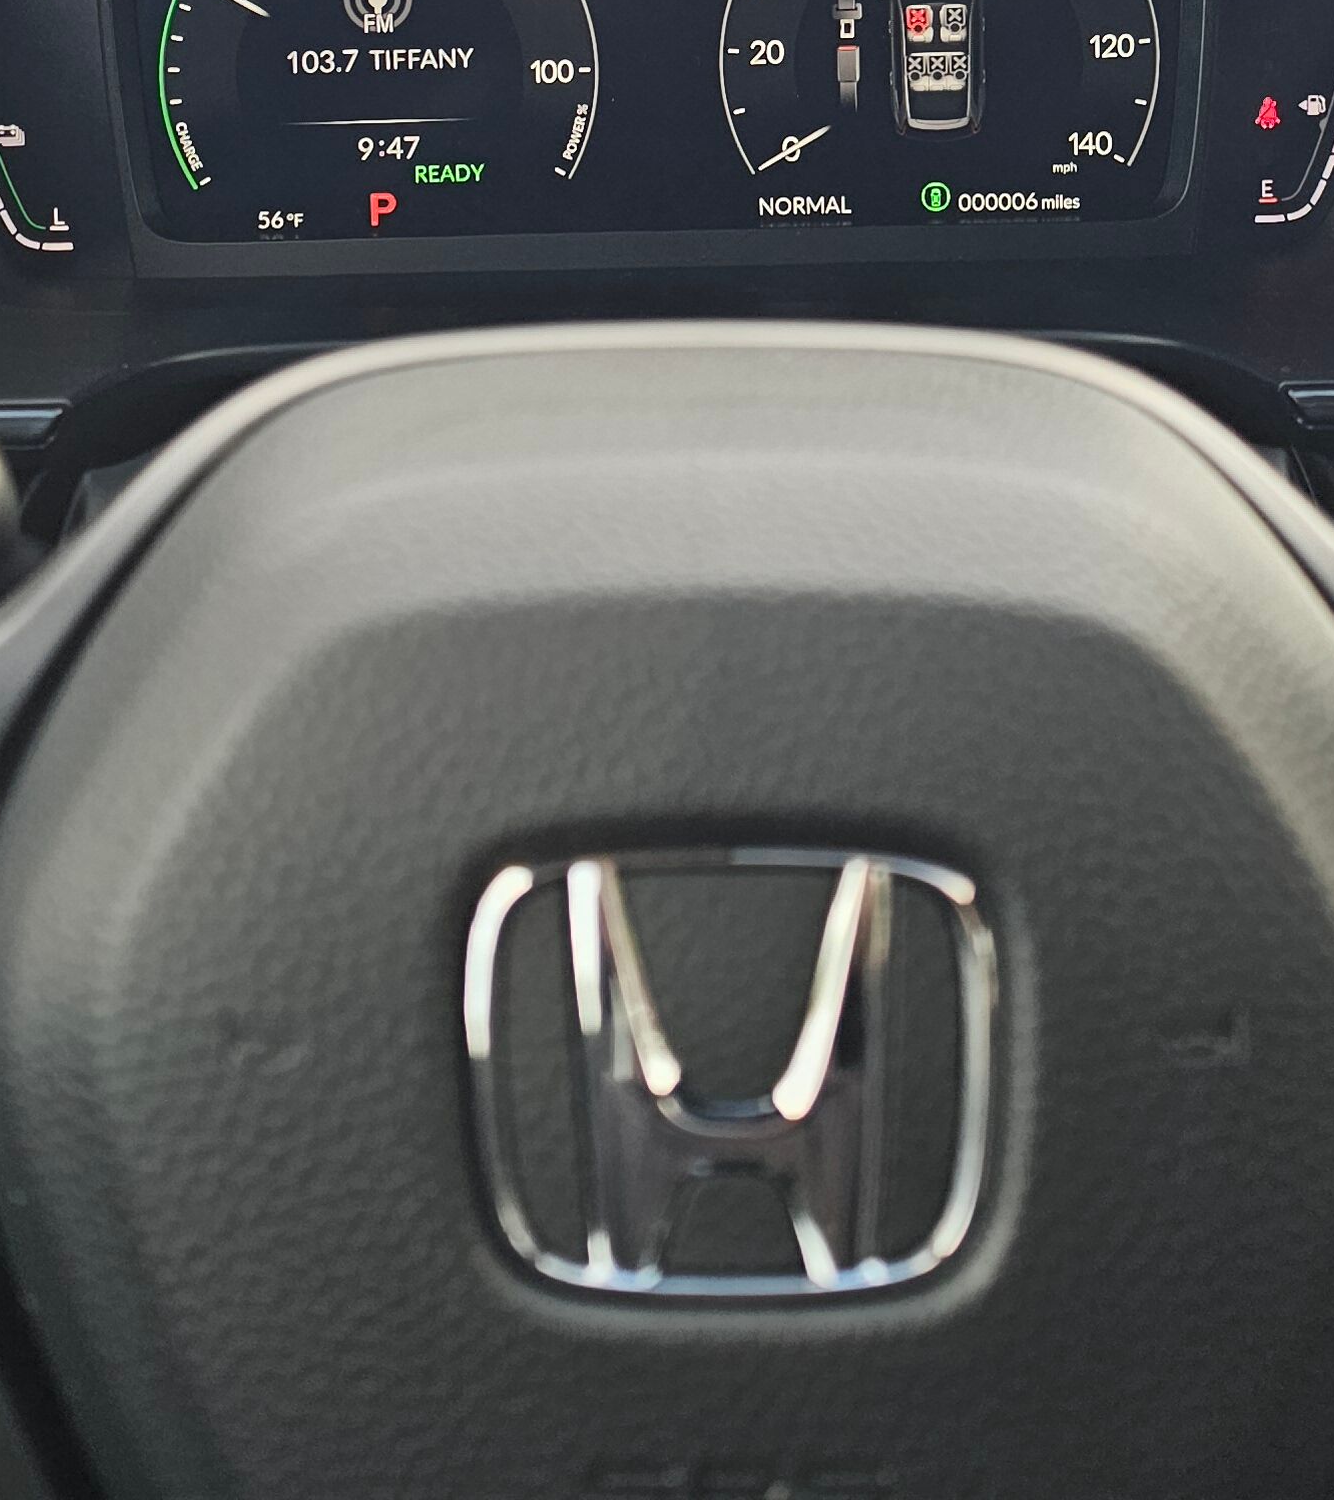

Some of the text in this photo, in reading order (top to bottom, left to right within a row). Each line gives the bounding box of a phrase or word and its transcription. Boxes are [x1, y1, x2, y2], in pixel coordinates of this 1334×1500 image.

[363, 14, 394, 34] FM
[749, 39, 785, 66] 20
[1089, 33, 1135, 60] 120
[287, 47, 475, 74] 103.7 TIFFANY
[530, 59, 574, 84] 100
[175, 121, 204, 171] CHARGE
[357, 135, 420, 161] 9:47
[1068, 131, 1113, 157] 140
[414, 163, 485, 184] READY
[1052, 160, 1078, 176] mph
[1261, 179, 1274, 198] E
[369, 192, 397, 227] P
[758, 196, 852, 217] NORMAL
[957, 192, 1081, 212] 000006 miles
